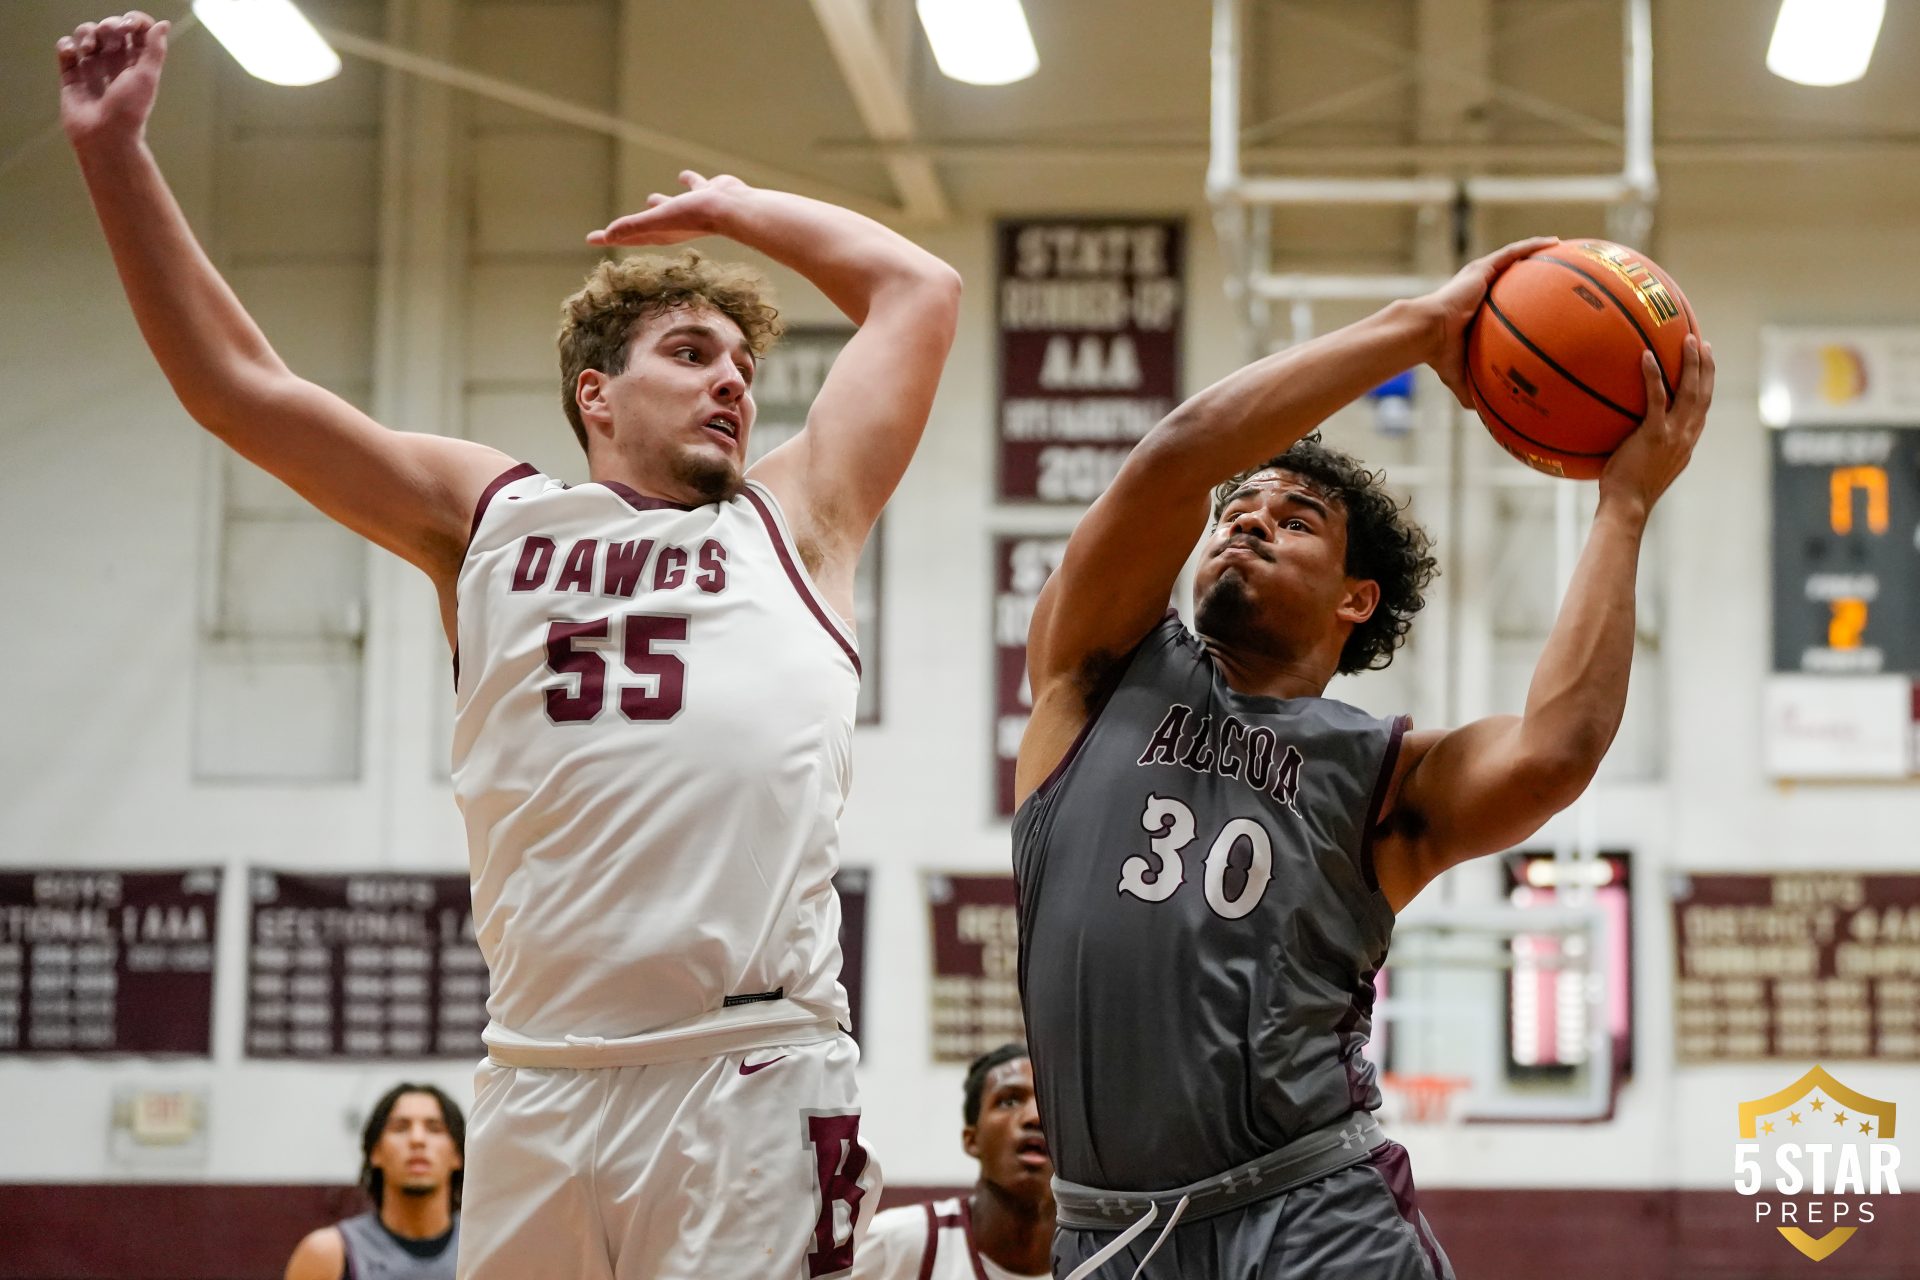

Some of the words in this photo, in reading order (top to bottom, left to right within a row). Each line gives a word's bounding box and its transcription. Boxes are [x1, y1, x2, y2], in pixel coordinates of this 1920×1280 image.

[1039, 333, 1143, 389] AAA
[509, 534, 728, 599] DAWGS
[543, 612, 691, 727] 55
[1137, 704, 1304, 818] ALCOA
[1118, 792, 1276, 921] 30
